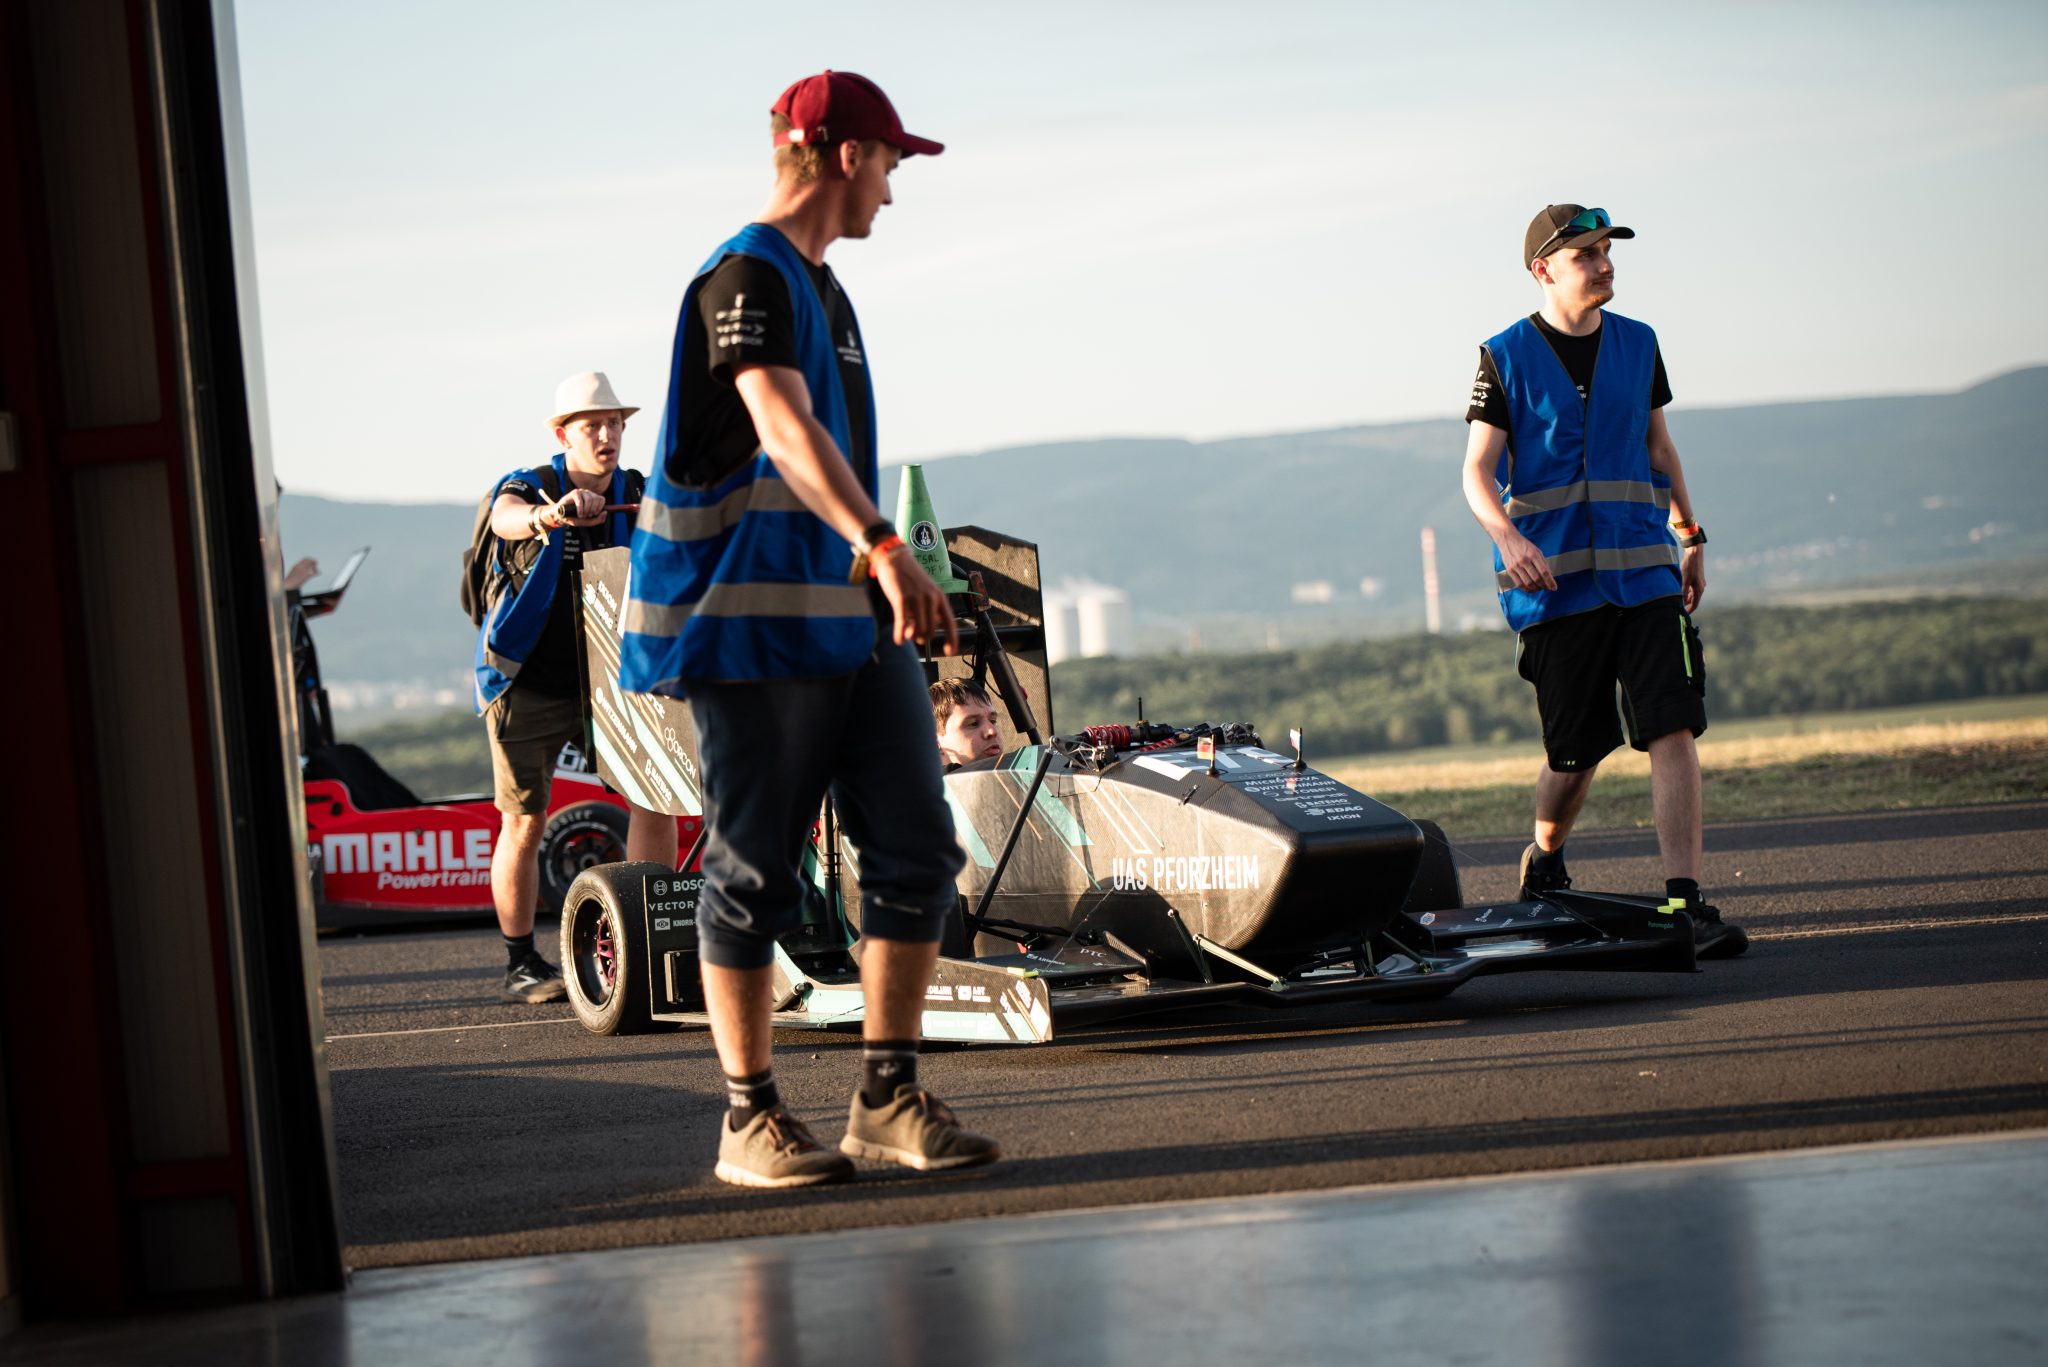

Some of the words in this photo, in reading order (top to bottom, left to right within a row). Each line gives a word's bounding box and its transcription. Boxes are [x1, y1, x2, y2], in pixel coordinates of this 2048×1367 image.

[673, 741, 696, 779] ORCON
[1325, 805, 1364, 813] EDAG
[323, 829, 492, 873] MAHLE
[377, 868, 490, 890] Powertrain
[1112, 856, 1148, 891] UAS
[1153, 855, 1260, 891] PFORZHEIM
[673, 879, 706, 892] BOSC
[648, 900, 695, 912] VECTOR
[1080, 947, 1107, 958] PTC
